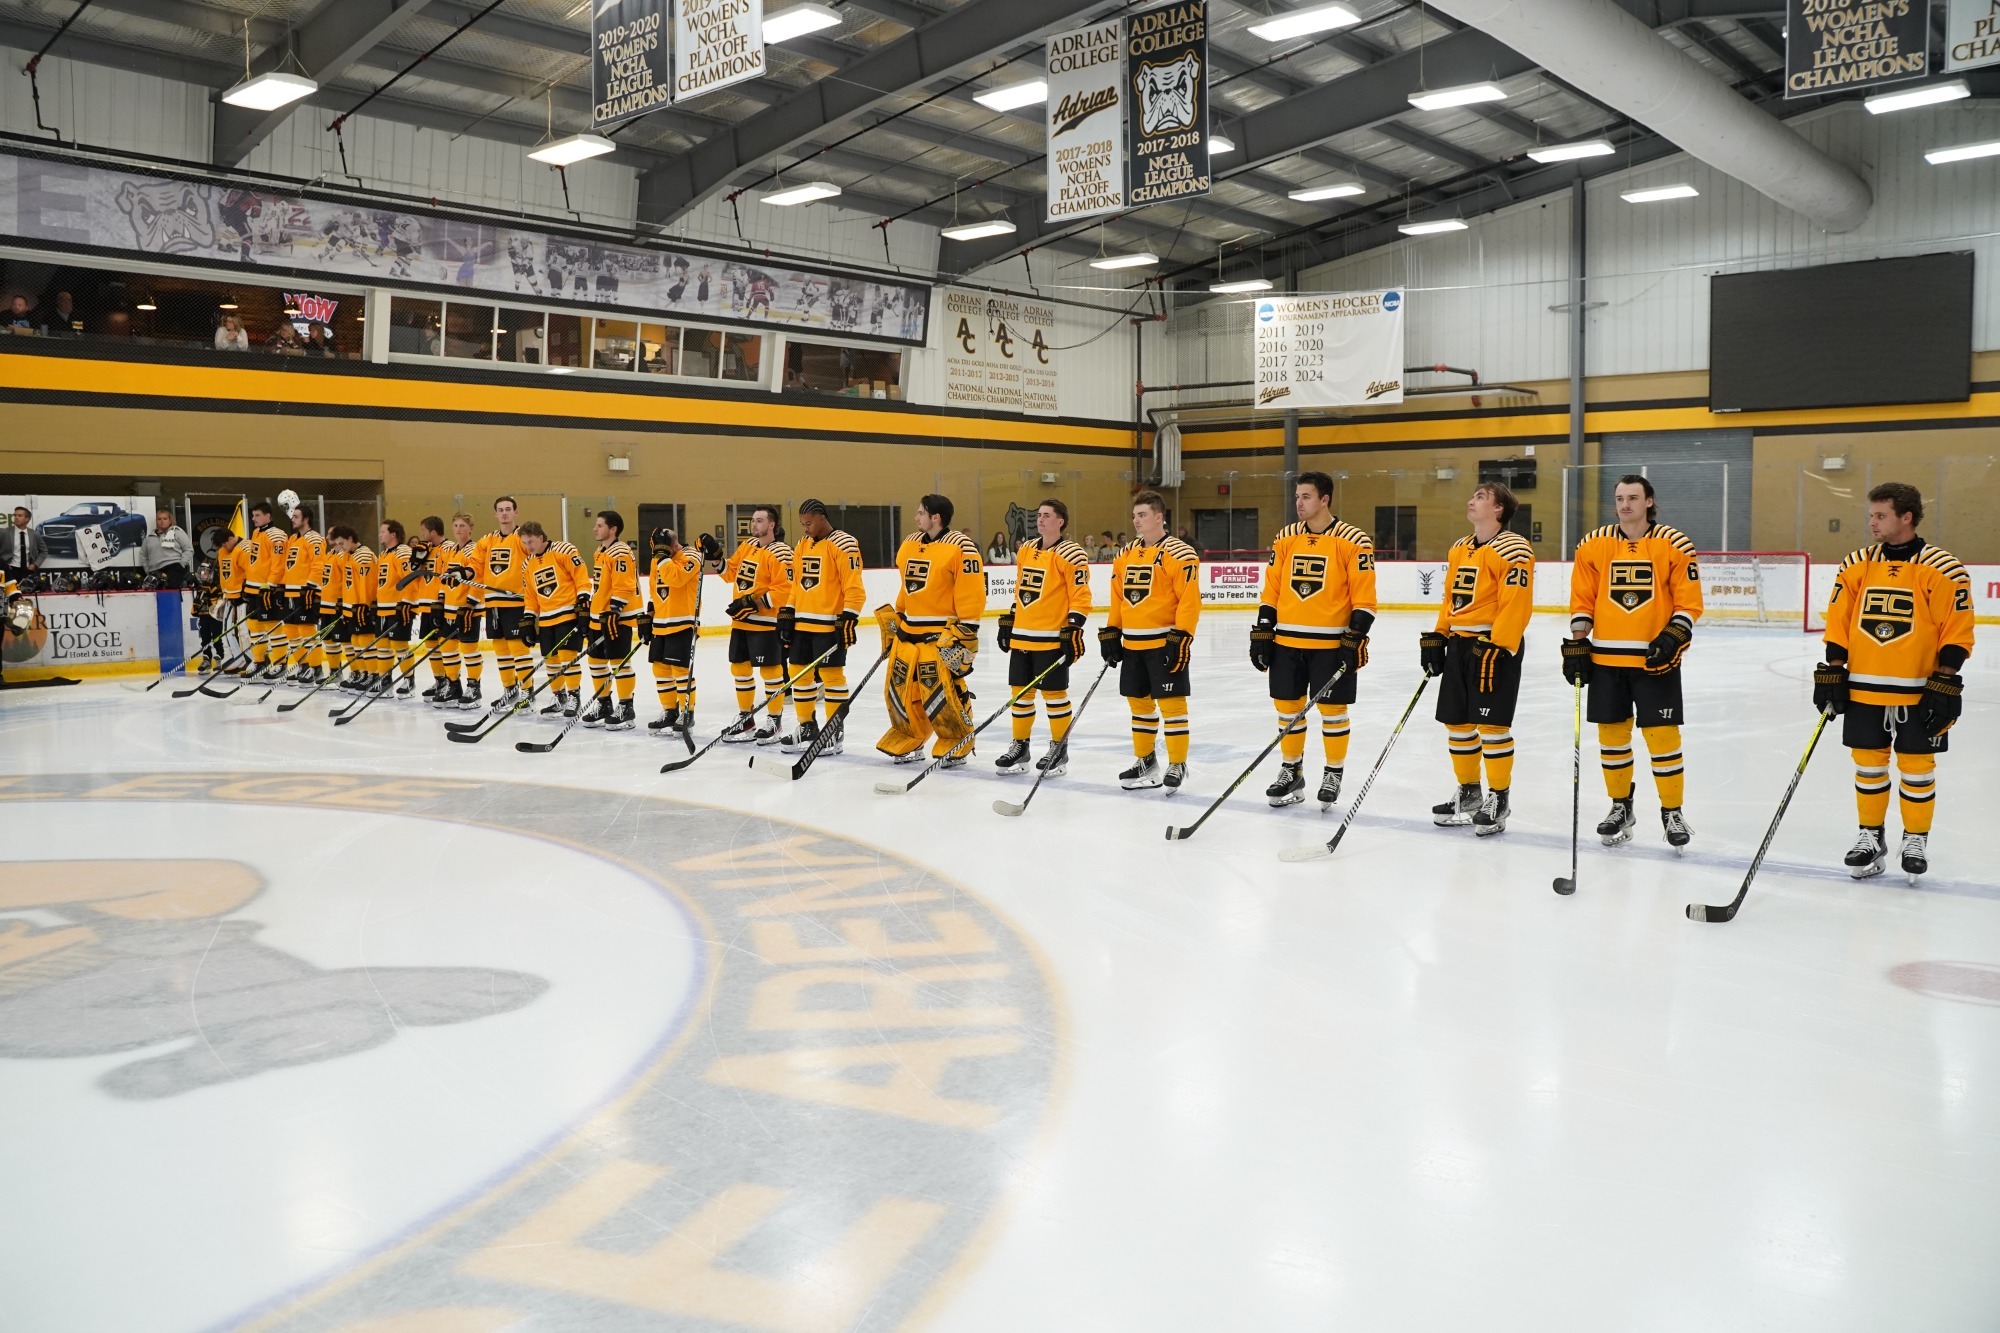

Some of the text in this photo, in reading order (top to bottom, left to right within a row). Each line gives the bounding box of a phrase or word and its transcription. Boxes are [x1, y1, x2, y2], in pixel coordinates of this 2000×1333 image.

[687, 0, 750, 32] WOMEN'S
[1130, 2, 1204, 38] ADRIAN
[1806, 0, 1910, 32] WOMEN'S
[599, 13, 659, 49] 2019-2020
[698, 22, 738, 48] NCHA
[1129, 22, 1204, 56] COLLEGE
[1822, 21, 1890, 48] NCHA
[602, 32, 658, 66] WOMEN'S
[1050, 25, 1118, 57] ADRIAN
[690, 34, 748, 70] PLAYOFF
[1050, 44, 1118, 74] COLLEGE
[1814, 37, 1898, 68] LEAGUE
[611, 54, 648, 81] NCHA
[678, 50, 762, 92] CHAMPIONS
[1789, 52, 1924, 91] CHAMPIONS
[607, 69, 652, 100] LEAGUE
[594, 84, 667, 121] CHAMPIONS
[1053, 86, 1118, 125] Adrian
[1056, 140, 1112, 162] 2017-2018
[1137, 132, 1200, 156] 2017-2018
[1059, 155, 1110, 174] WOMEN'S
[1149, 152, 1188, 172] NCHA
[1067, 170, 1102, 186] NCHA
[1144, 164, 1194, 186] LEAGUE
[1060, 181, 1109, 200] PLAYOFF
[1131, 176, 1208, 202] CHAMPIONS
[1050, 193, 1120, 216] CHAMPIONS
[948, 294, 981, 306] ADRIAN
[986, 300, 1018, 311] ADRIAN
[1277, 294, 1381, 312] WOMEN'S HOCKEY
[948, 303, 982, 316] COLLEGE
[986, 309, 1020, 320] COLLEGE
[1024, 306, 1053, 317] ADRIAN
[1279, 306, 1380, 322] TOURNAMENT APPEARANCES
[1024, 315, 1054, 327] COLLEGE
[1260, 324, 1324, 338] 2011 2019
[1259, 339, 1324, 353] 2016 2020
[1259, 354, 1324, 368] 2017 2023
[1259, 370, 1324, 382] 2018 2024
[948, 383, 984, 393] NATIONAL
[988, 387, 1022, 396] NATIONAL
[1260, 386, 1290, 400] Adrian
[1366, 380, 1400, 395] Adrian
[948, 392, 985, 402] CHAMPIONS
[986, 395, 1022, 405] CHAMPIONS
[1024, 392, 1056, 402] NATIONAL
[1024, 401, 1058, 410] CHAMPIONS
[274, 546, 284, 554] 82
[314, 546, 320, 556] 2
[1154, 550, 1164, 566] A
[360, 567, 370, 576] 47
[616, 560, 626, 572] 15
[684, 560, 694, 572] 3
[849, 556, 860, 570] 14
[963, 559, 980, 574] 30
[1688, 562, 1698, 580] 6
[1506, 568, 1528, 588] 26
[1612, 566, 1652, 584] AC
[992, 588, 1006, 596] (313)
[1201, 592, 1216, 600] ping
[1864, 594, 1913, 614] AC
[29, 612, 107, 630] RLTON
[50, 630, 122, 658] LODGE
[801, 714, 842, 772] WARRIOR
